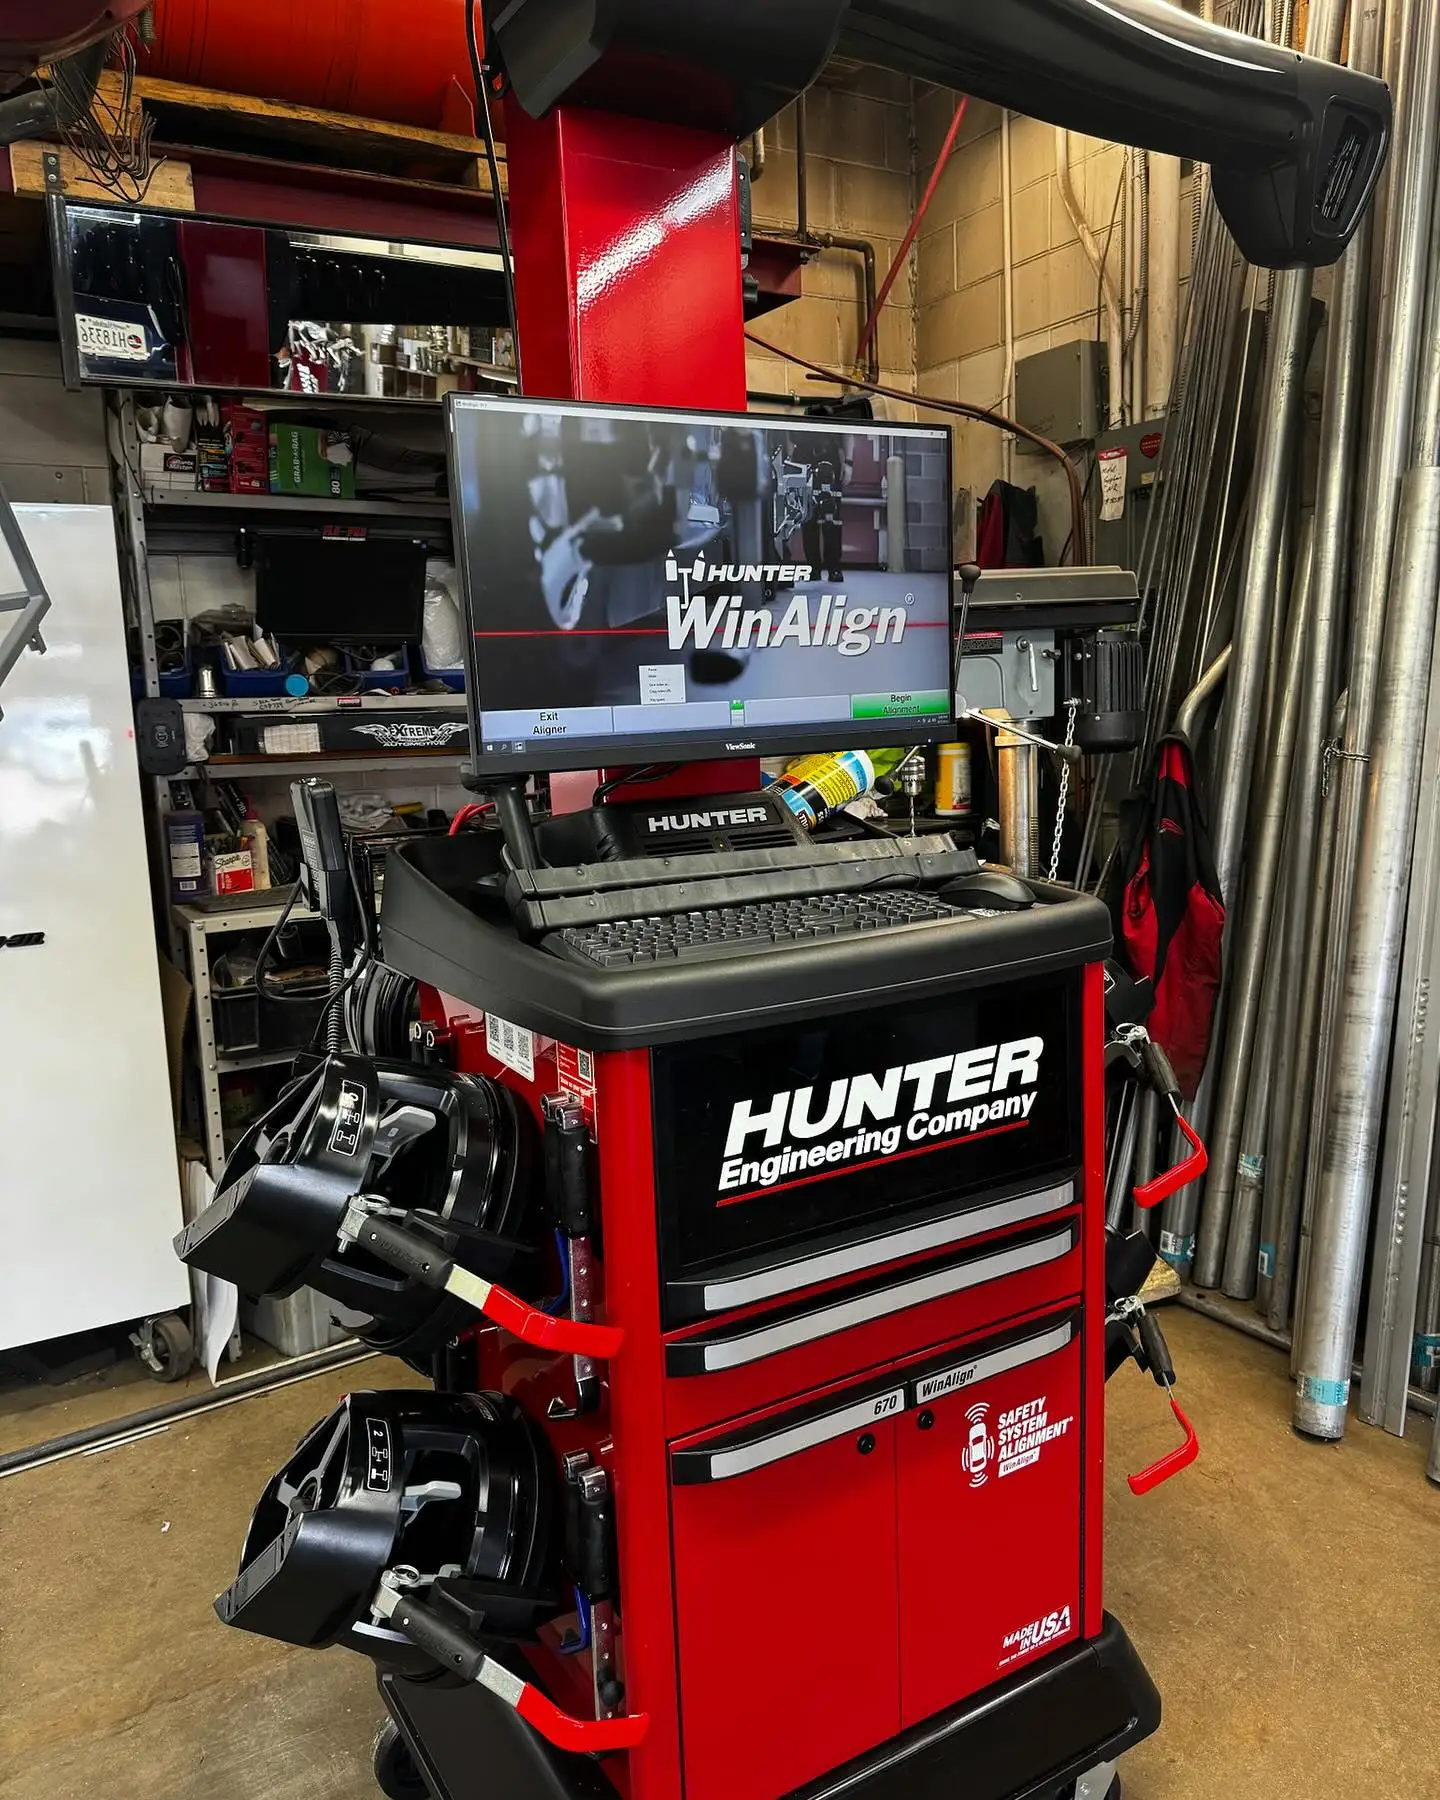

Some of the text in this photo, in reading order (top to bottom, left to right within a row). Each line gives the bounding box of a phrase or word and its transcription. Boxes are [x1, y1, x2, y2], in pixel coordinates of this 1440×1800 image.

[331, 480, 341, 494] 80
[707, 564, 813, 582] HUNTER
[883, 705, 920, 715] Alignment
[890, 694, 912, 704] Begin
[539, 711, 559, 721] Exit
[532, 725, 567, 736] Aligner
[725, 742, 756, 751] ViewSonic
[647, 806, 768, 833] HUNTER
[723, 1035, 1045, 1158] HUNTER
[718, 1091, 1038, 1191] Engineering Company
[874, 1394, 897, 1416] 670
[998, 1396, 1047, 1430] SAFETY
[998, 1411, 1048, 1446] SYSTEM
[998, 1418, 1071, 1462] ALIGNMENT
[1003, 1623, 1034, 1648] MADE
[1031, 1605, 1071, 1644] USA
[1020, 1637, 1032, 1650] IN
